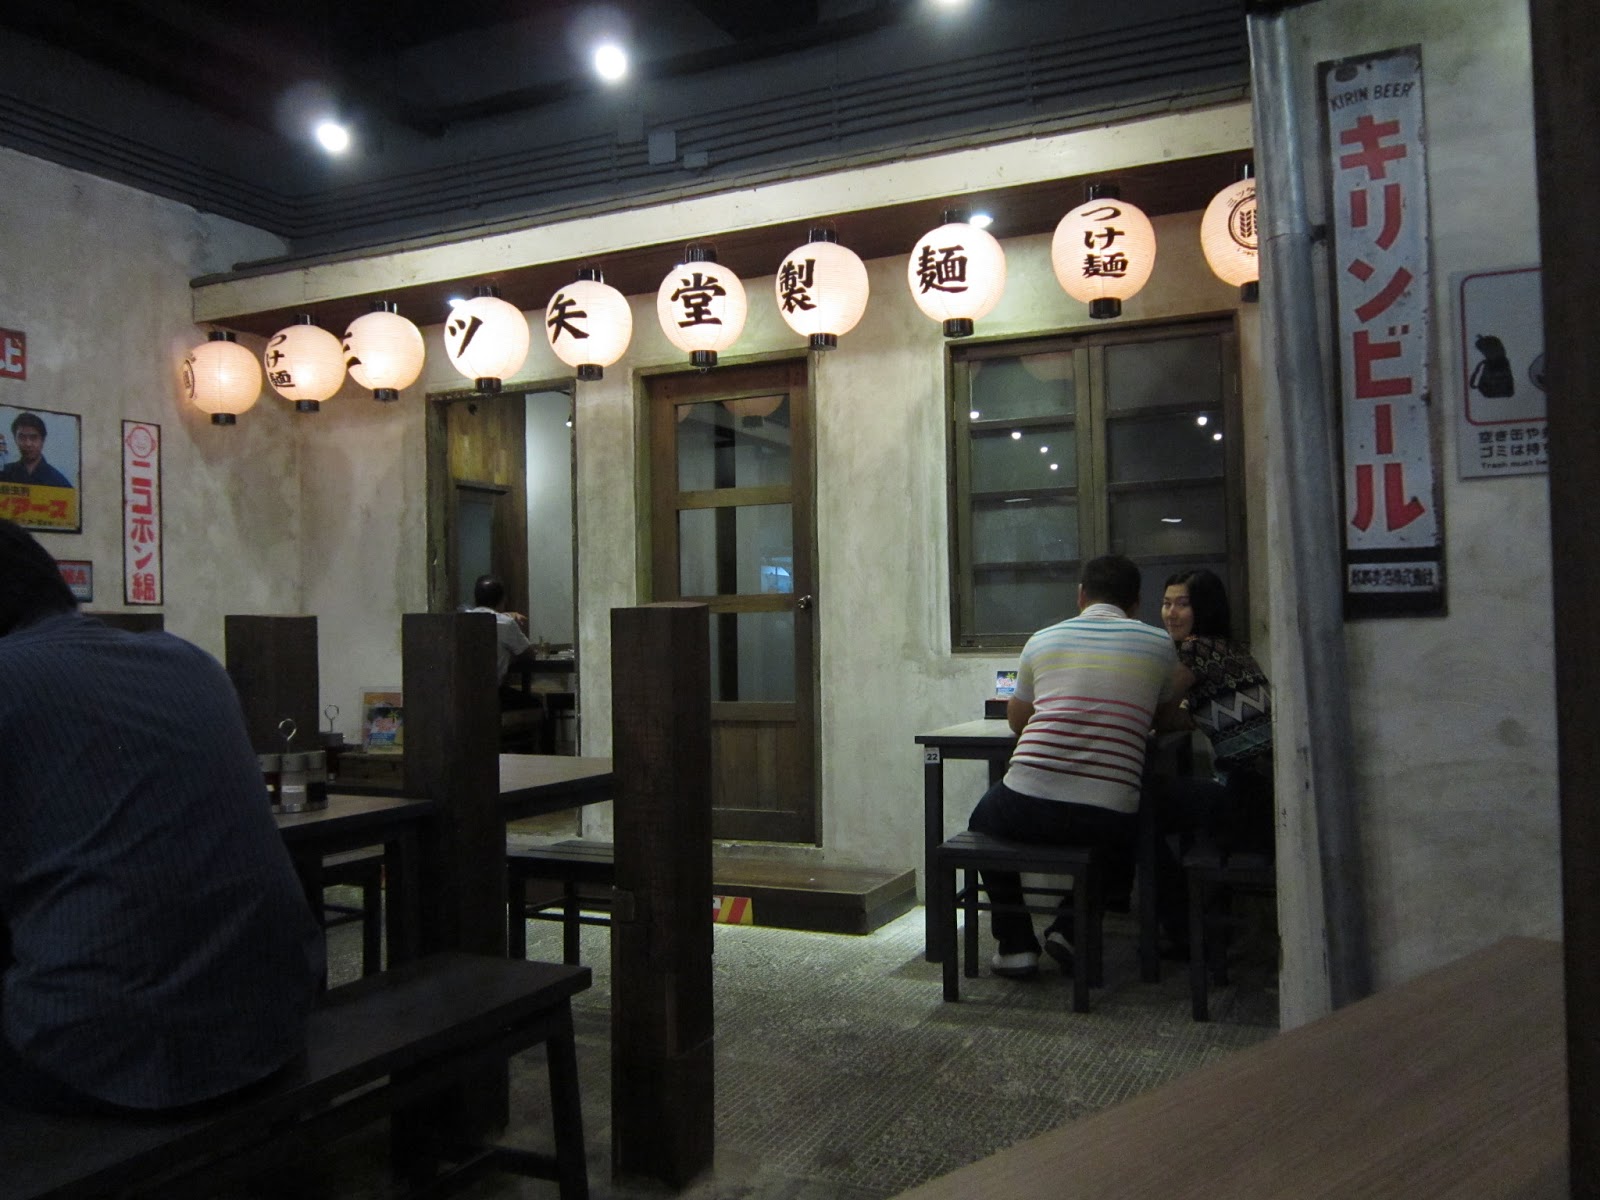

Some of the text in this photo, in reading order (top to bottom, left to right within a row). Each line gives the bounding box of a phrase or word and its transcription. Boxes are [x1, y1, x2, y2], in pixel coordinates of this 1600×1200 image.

[1329, 82, 1416, 112] KIRIN BEER
[1080, 205, 1128, 279] つけ麺
[779, 258, 817, 314] 製
[916, 244, 969, 294] 麺
[547, 293, 590, 344] 矢
[670, 272, 727, 328] 堂
[1340, 114, 1427, 532] キリンビール
[448, 315, 484, 359] ツ
[926, 753, 938, 761] 22
